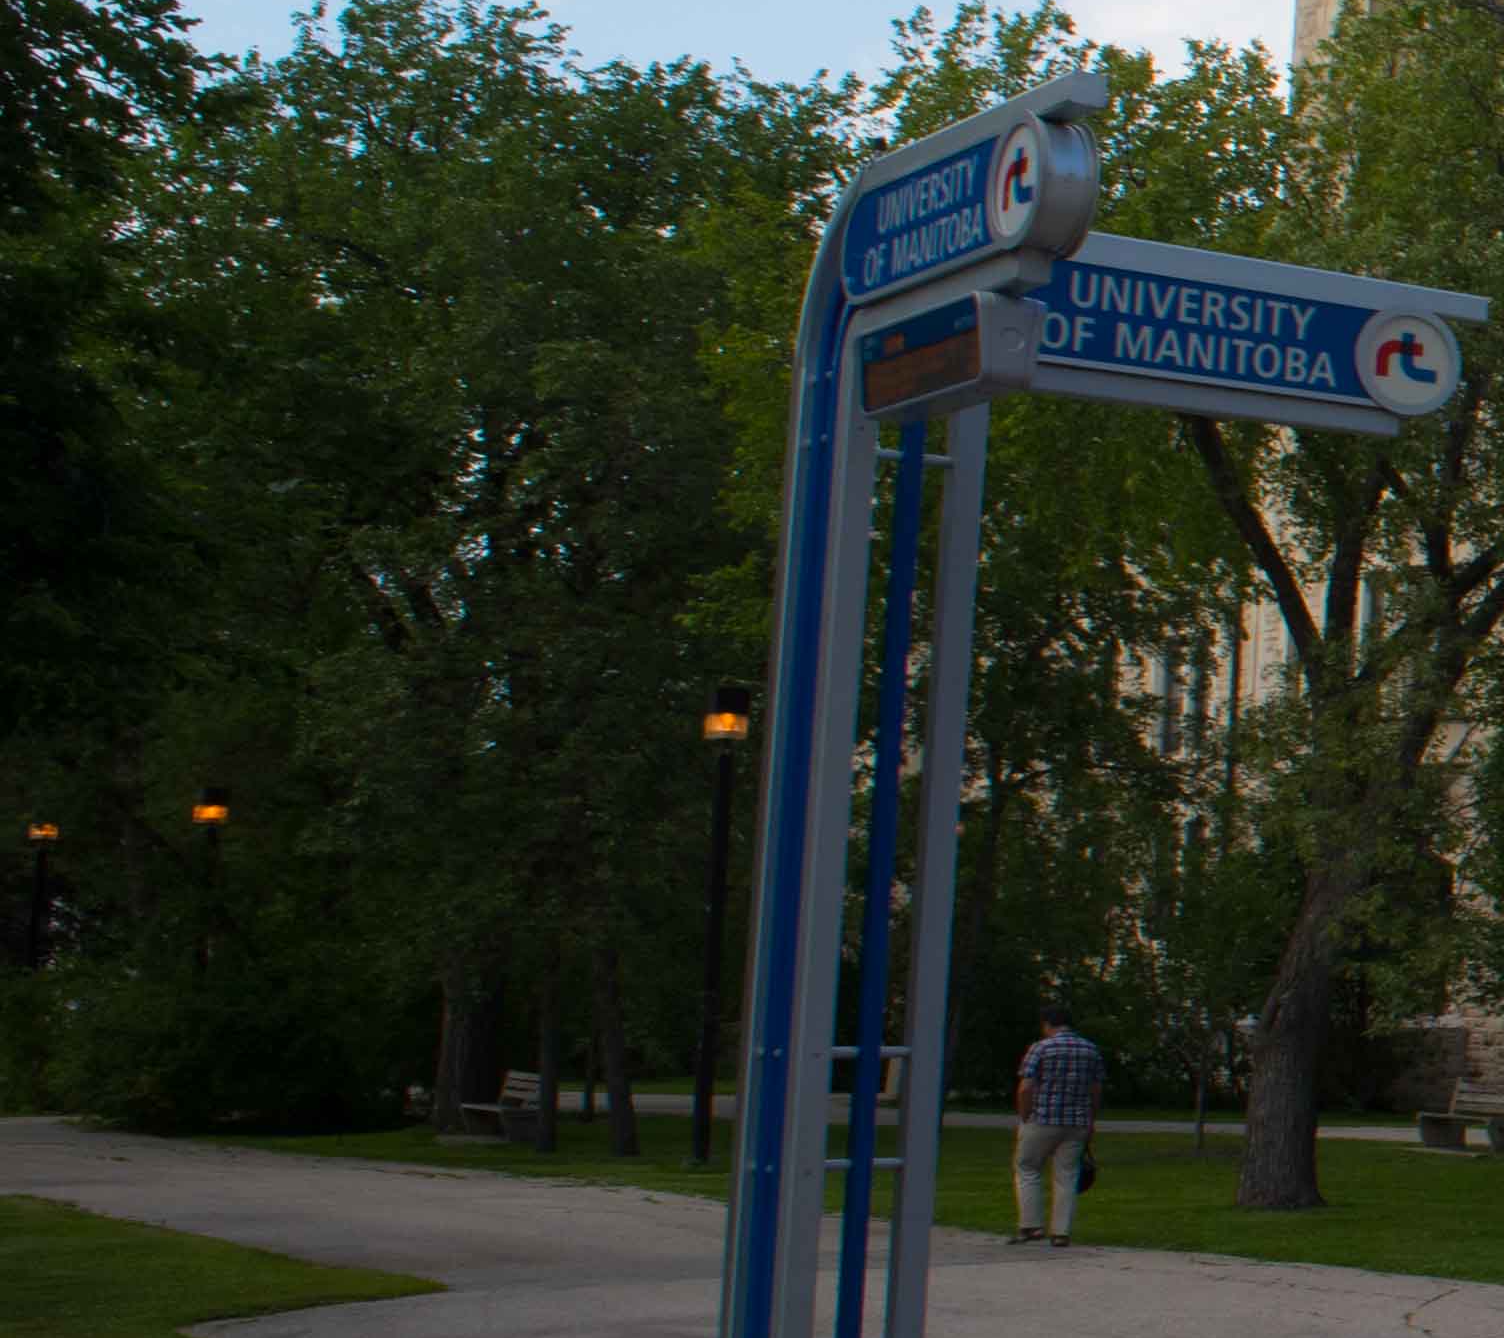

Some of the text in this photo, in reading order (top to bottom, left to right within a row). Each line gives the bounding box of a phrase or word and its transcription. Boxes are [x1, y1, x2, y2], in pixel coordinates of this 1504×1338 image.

[876, 154, 977, 235] UNIVERSITY
[863, 207, 986, 288] OF MANITOBA
[1068, 270, 1317, 341] UNIVERSITY
[1042, 313, 1338, 389] OF MANITOBA
